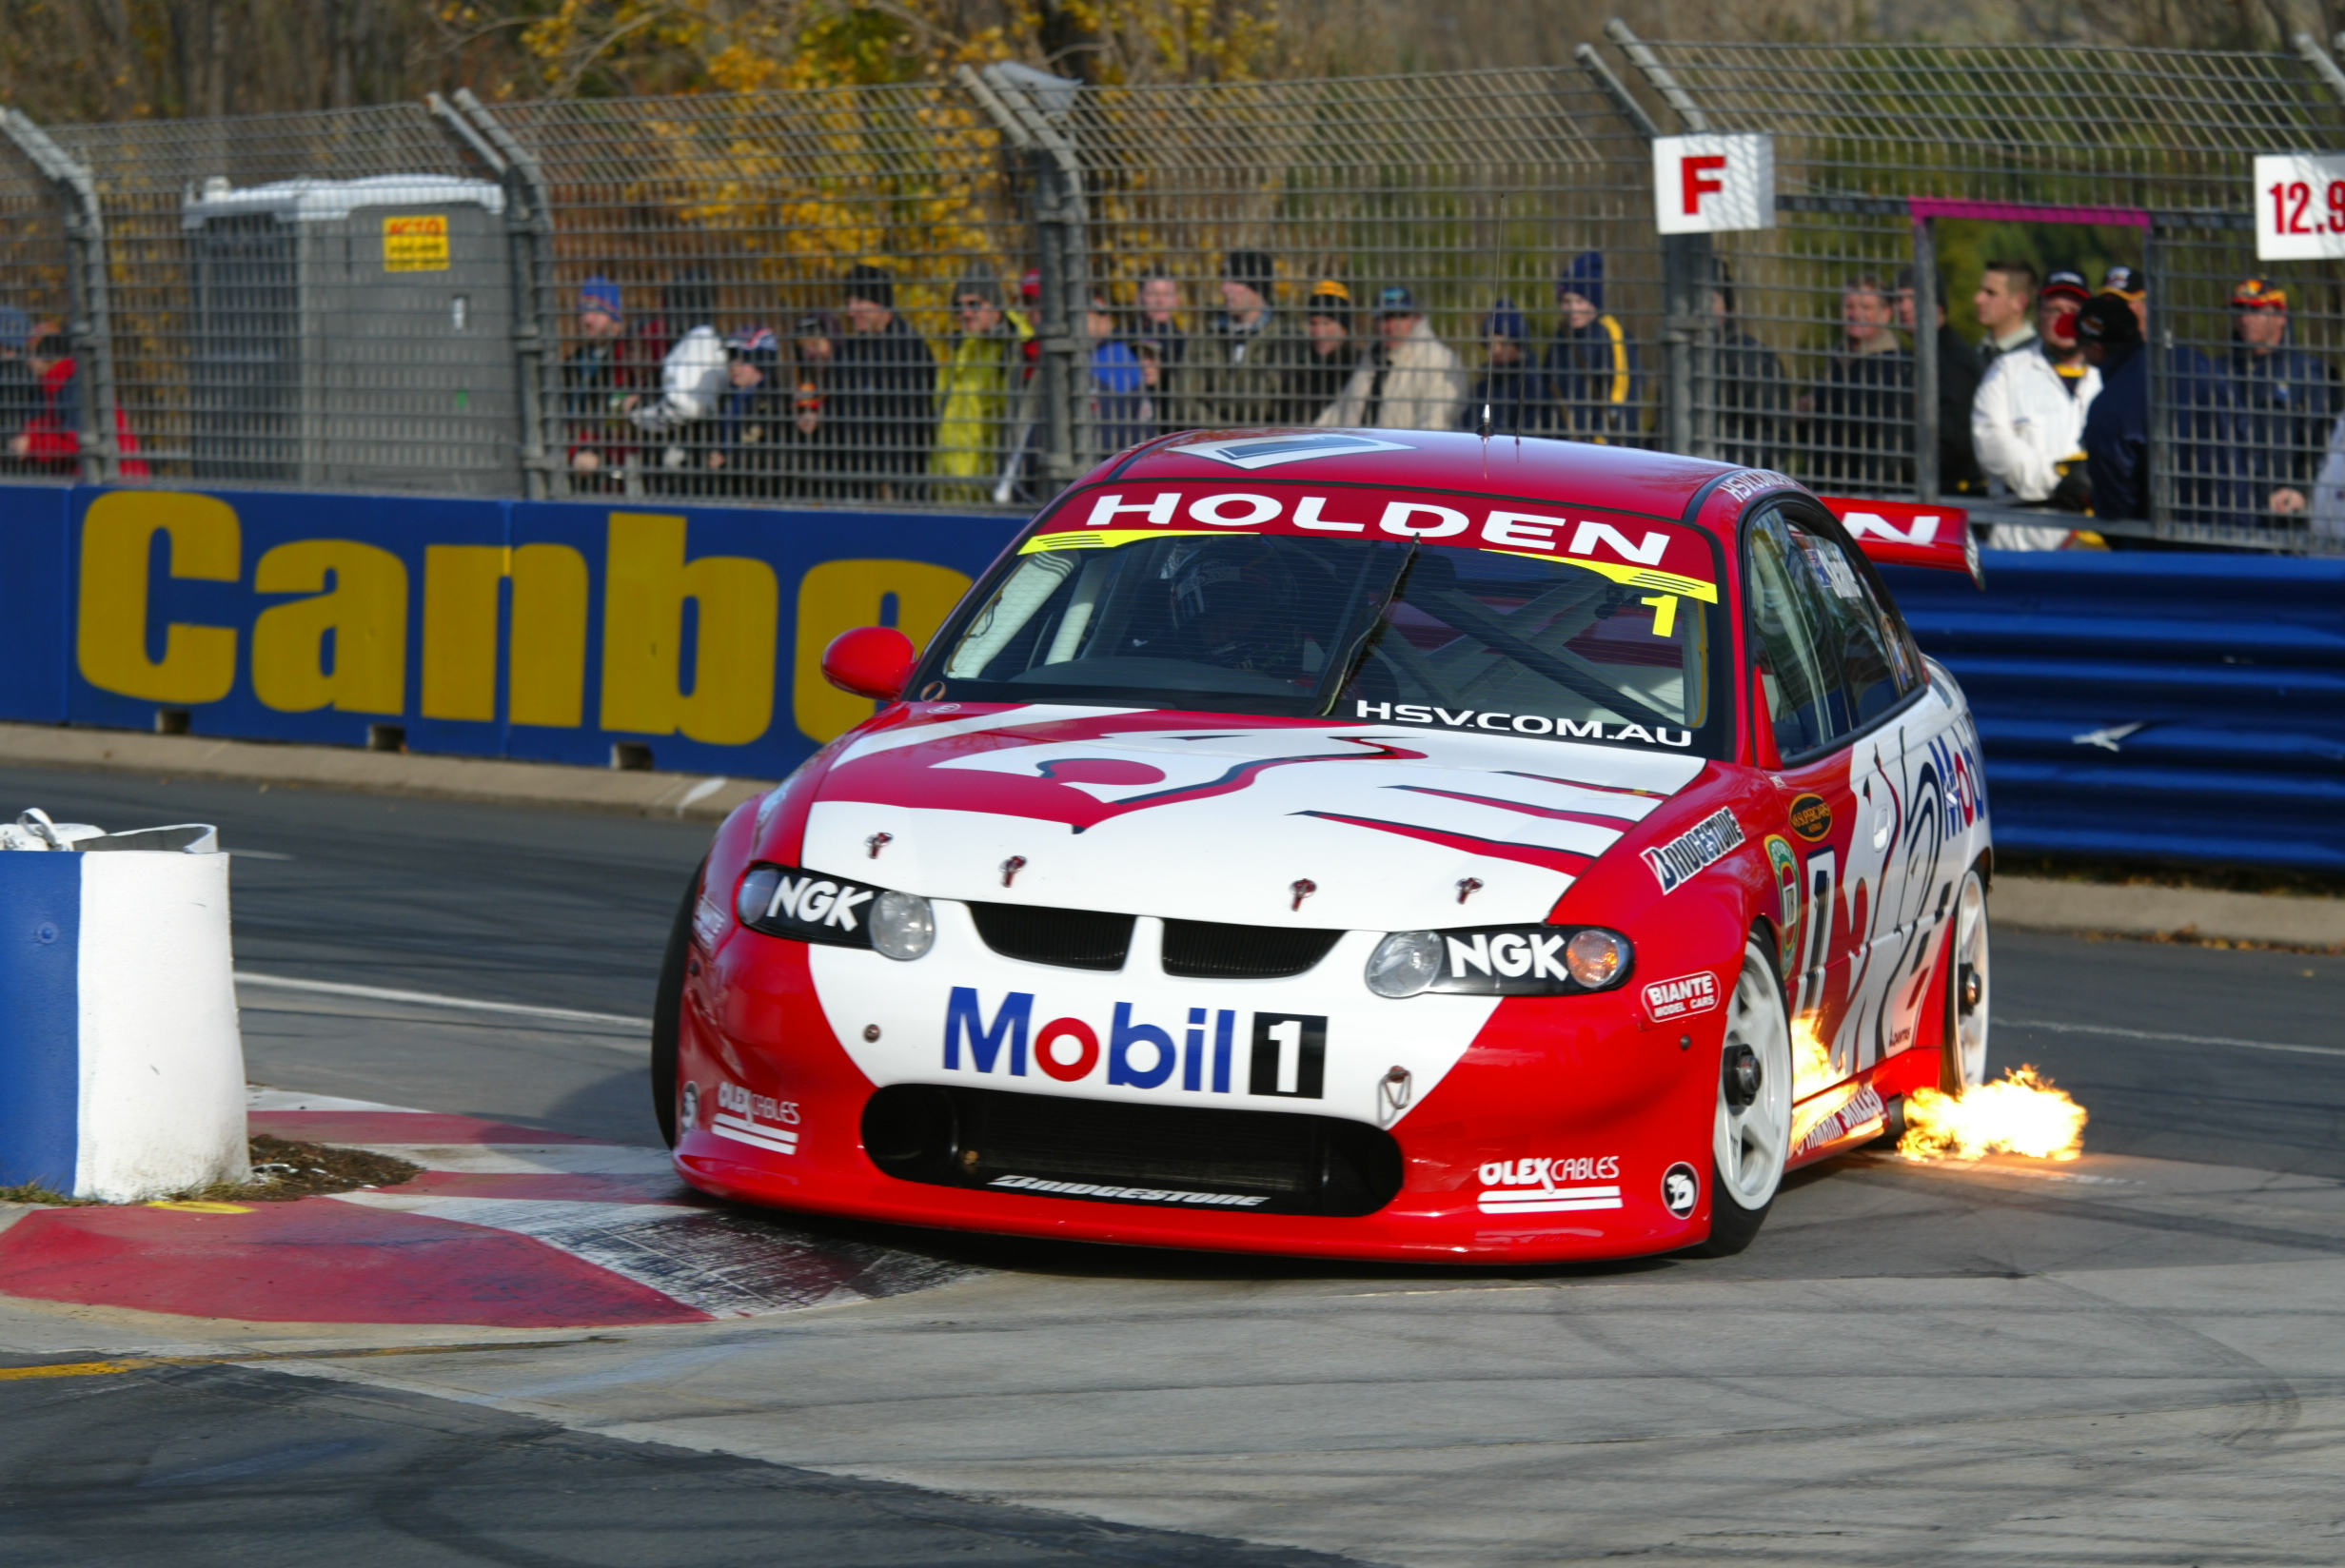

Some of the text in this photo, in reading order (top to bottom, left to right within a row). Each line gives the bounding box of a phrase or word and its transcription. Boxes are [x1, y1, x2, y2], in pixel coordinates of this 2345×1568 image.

[1681, 155, 1725, 215] F
[1086, 491, 1672, 567] HOLDEN
[1640, 593, 1679, 637] 1
[1356, 699, 1693, 748] HSV.COM.AU
[1640, 806, 1745, 895] BRIDGESTONE
[766, 875, 874, 932] NGK
[1446, 931, 1570, 982] NGK
[1646, 974, 1715, 1007] BIANTE
[943, 985, 1303, 1094] Mobil 1
[987, 1174, 1271, 1206] BRIDGESTONE
